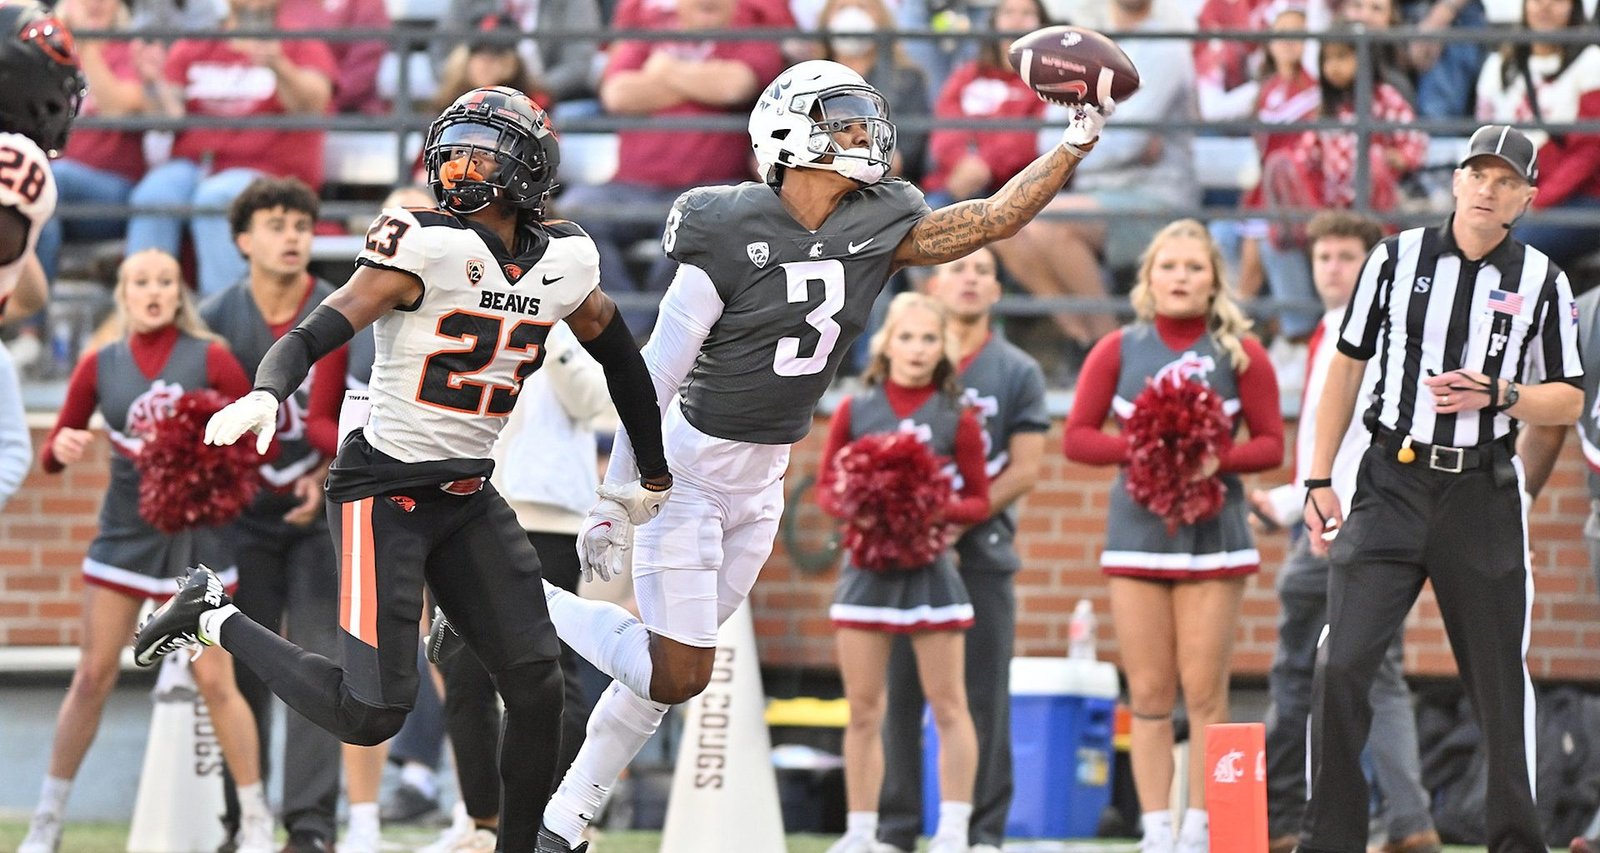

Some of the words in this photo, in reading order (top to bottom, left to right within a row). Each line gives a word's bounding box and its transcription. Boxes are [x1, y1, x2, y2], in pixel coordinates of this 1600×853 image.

[0, 145, 48, 204] 28
[364, 214, 412, 259] 23
[479, 290, 541, 315] BEAVS
[1413, 276, 1432, 294] S
[772, 258, 846, 377] 3
[416, 309, 554, 417] 23
[1488, 333, 1508, 357] F
[204, 573, 224, 608] NIKE
[711, 647, 734, 682] GO
[695, 694, 730, 788] COUGS
